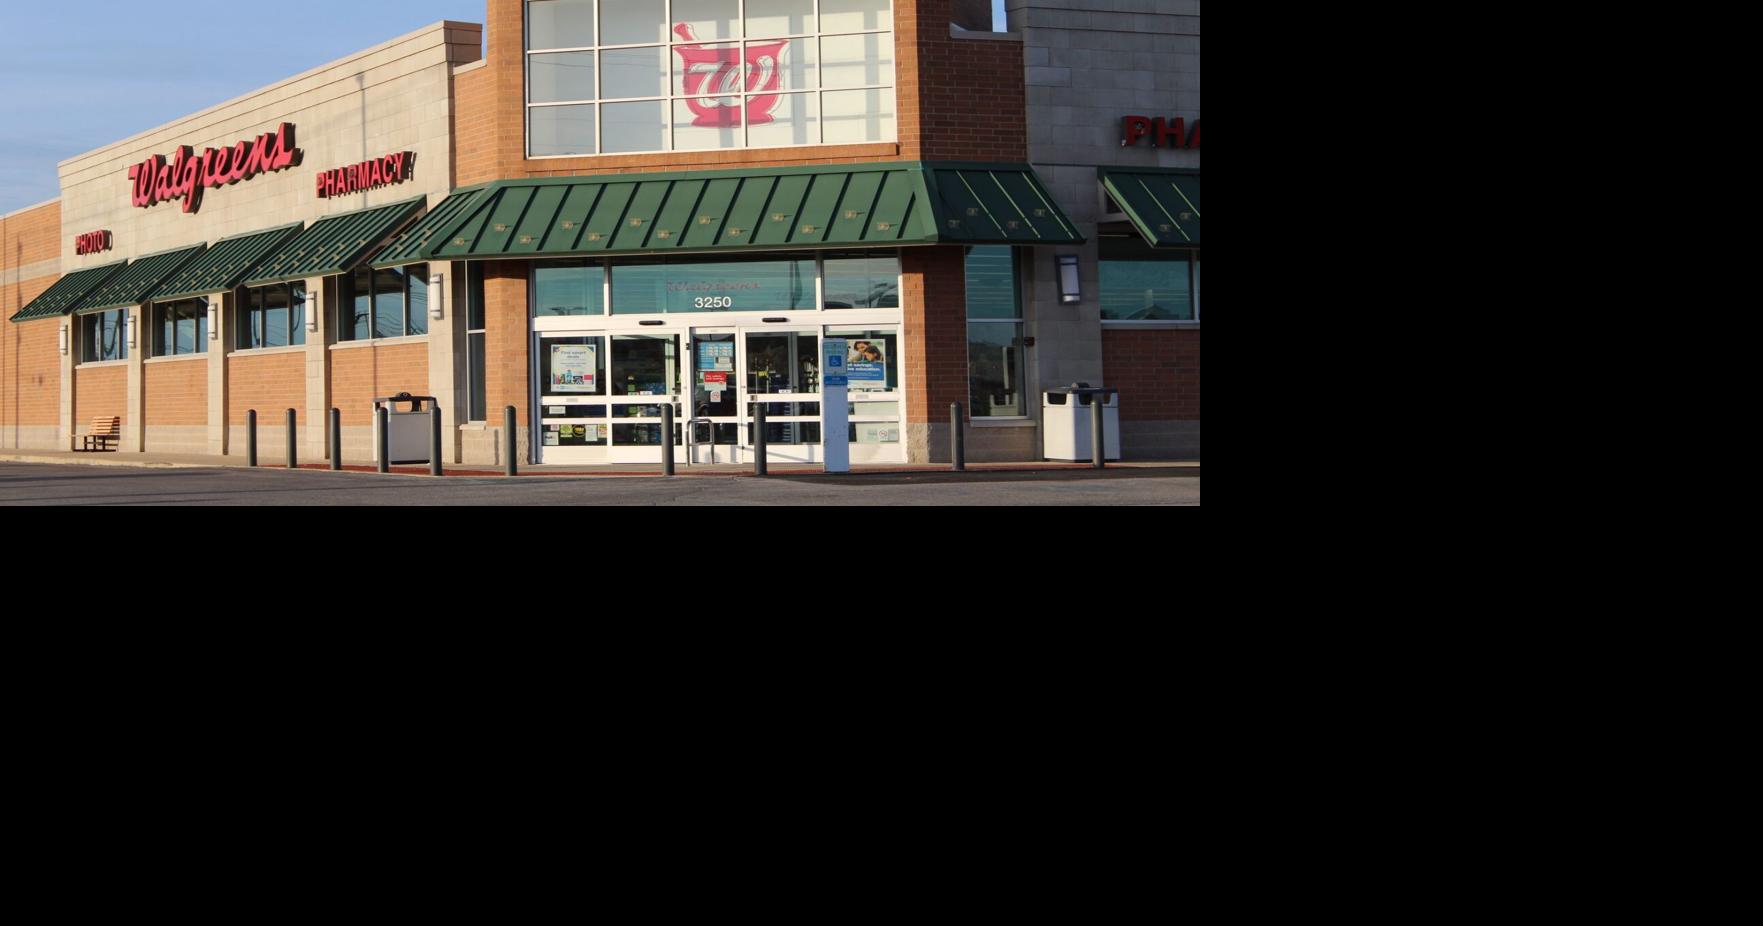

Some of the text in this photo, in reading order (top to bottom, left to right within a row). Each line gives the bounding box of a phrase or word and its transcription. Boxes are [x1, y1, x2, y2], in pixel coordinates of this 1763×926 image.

[128, 122, 301, 214] Walgreens
[317, 151, 412, 199] PHARMACY
[75, 229, 106, 256] PHOTO
[694, 296, 732, 309] 3250
